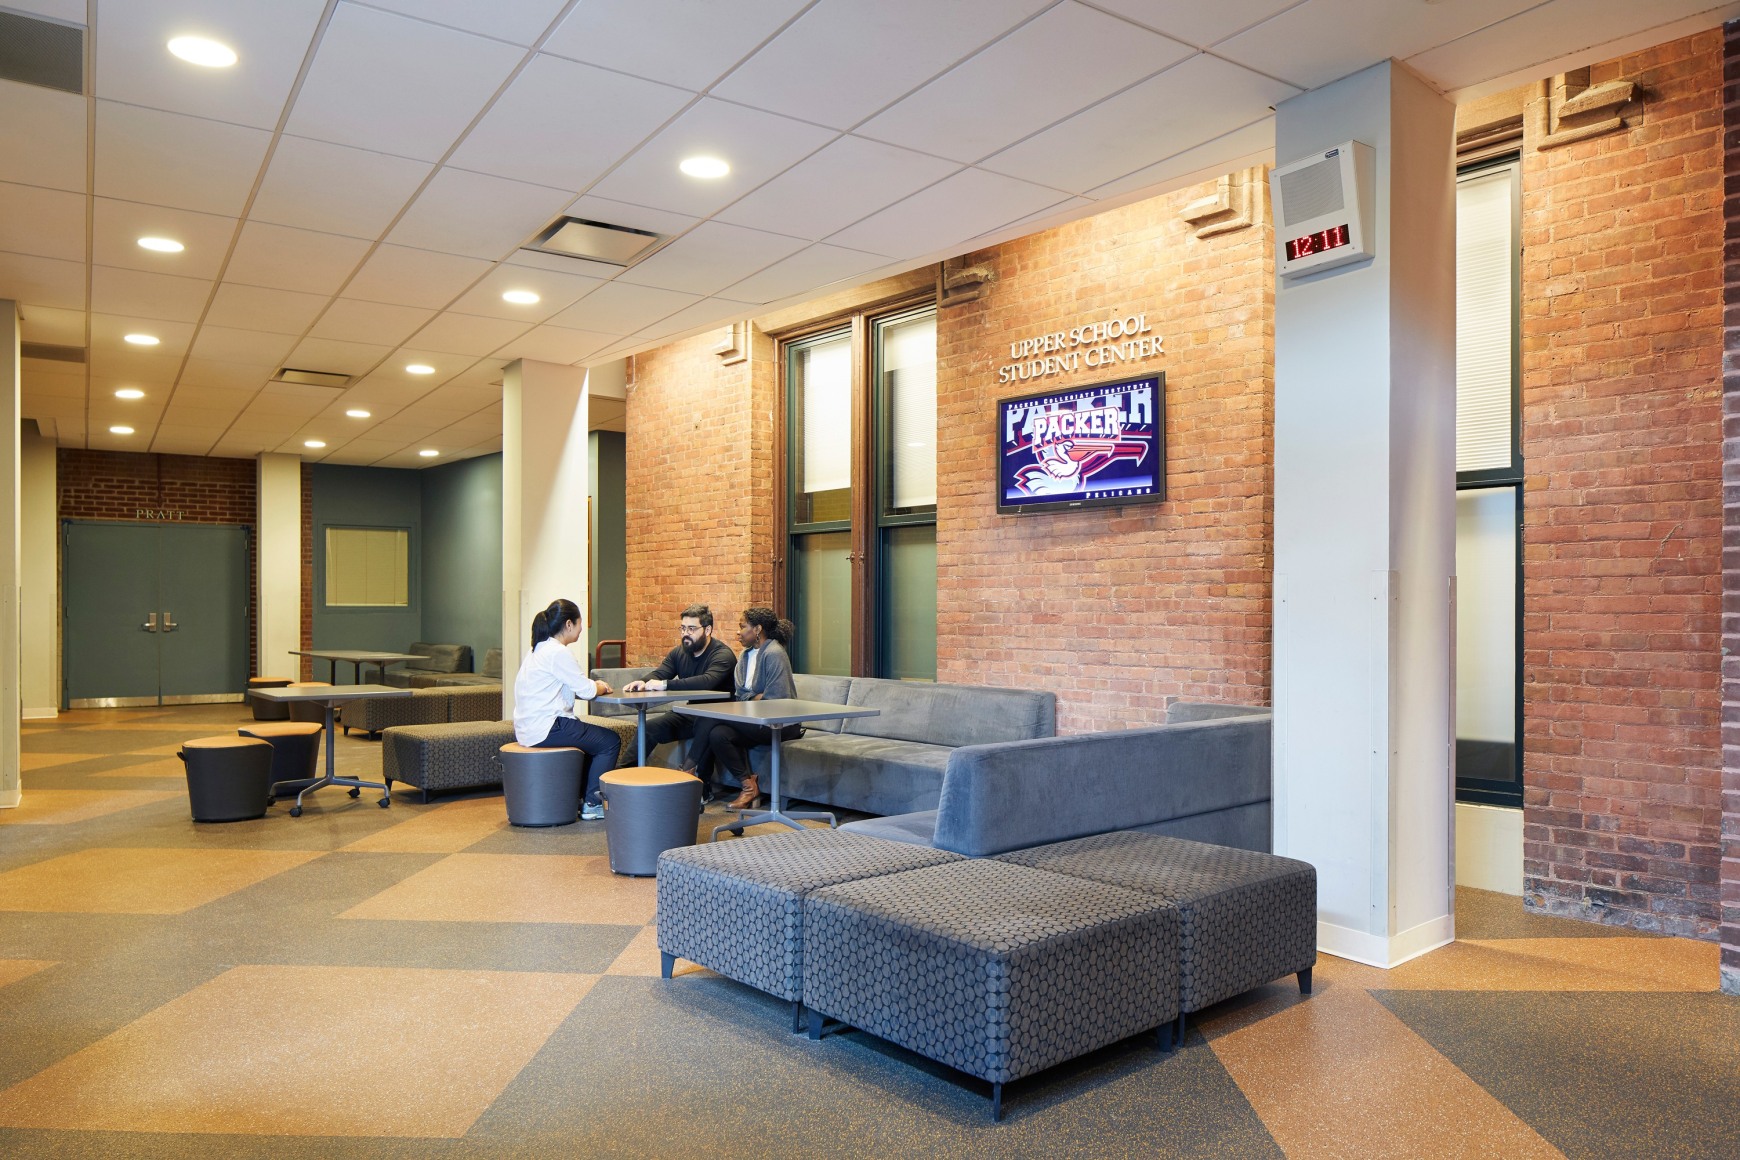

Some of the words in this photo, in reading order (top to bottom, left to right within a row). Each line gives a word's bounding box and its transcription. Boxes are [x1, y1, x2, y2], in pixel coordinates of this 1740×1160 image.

[1292, 226, 1343, 259] 12:11
[1010, 333, 1067, 360] UPPER
[1069, 315, 1152, 347] SCHOOL
[999, 352, 1080, 384] STUDENT
[1085, 336, 1165, 367] CENTER
[1100, 382, 1150, 396] INSTITUTE
[1034, 407, 1118, 444] PACKER
[1086, 488, 1151, 499] PELICANS
[136, 509, 185, 520] PRATT
